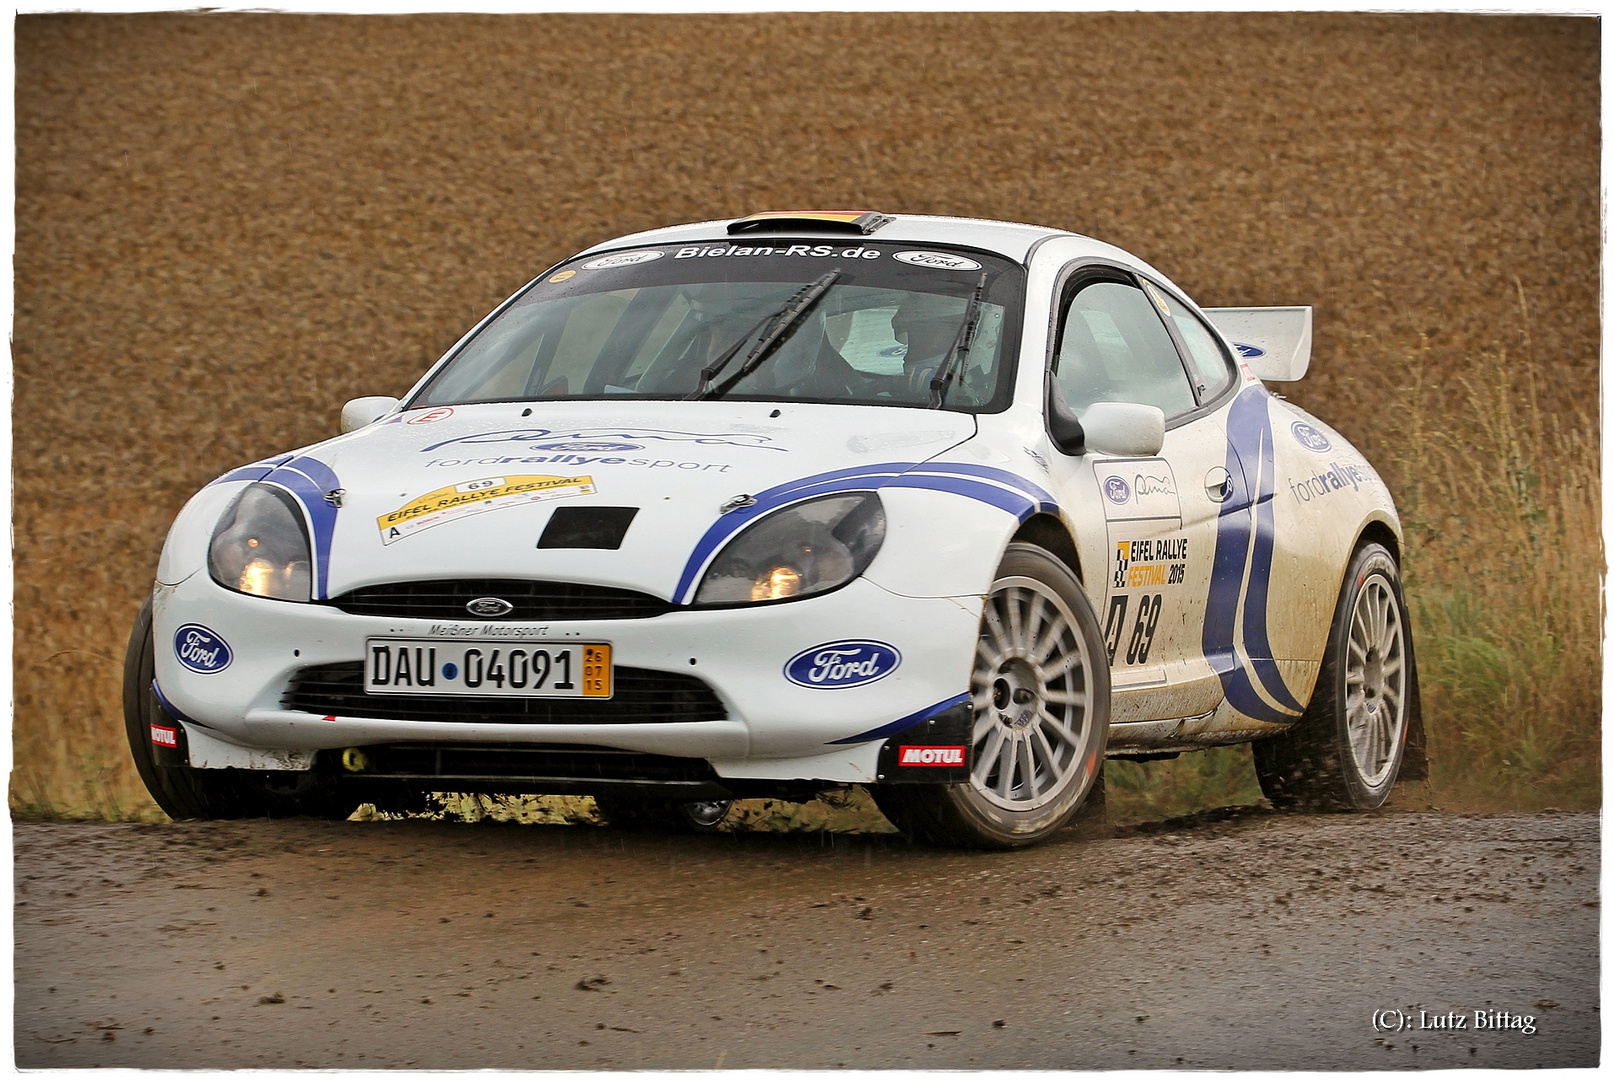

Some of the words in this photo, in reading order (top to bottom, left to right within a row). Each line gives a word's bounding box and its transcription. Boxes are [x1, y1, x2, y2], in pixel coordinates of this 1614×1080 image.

[674, 244, 882, 260] Bielan-RS.de
[425, 454, 734, 473] fordrallyesport
[467, 480, 494, 490] 69
[387, 505, 430, 523] EIFEL
[437, 489, 501, 508] RALLYE
[505, 477, 584, 494] FESTIVAL
[388, 526, 401, 539] A
[1131, 540, 1153, 562] EIFEL
[1156, 538, 1187, 560] RALLYE
[1127, 564, 1166, 587] FESTIVAL
[1168, 563, 1185, 585] 2015
[479, 624, 549, 639] Motorsport
[1126, 594, 1162, 665] 69
[371, 646, 436, 687] DAU
[464, 648, 575, 690] 04091
[808, 648, 880, 683] Ford
[586, 679, 603, 690] 15
[902, 749, 963, 764] MOTUL
